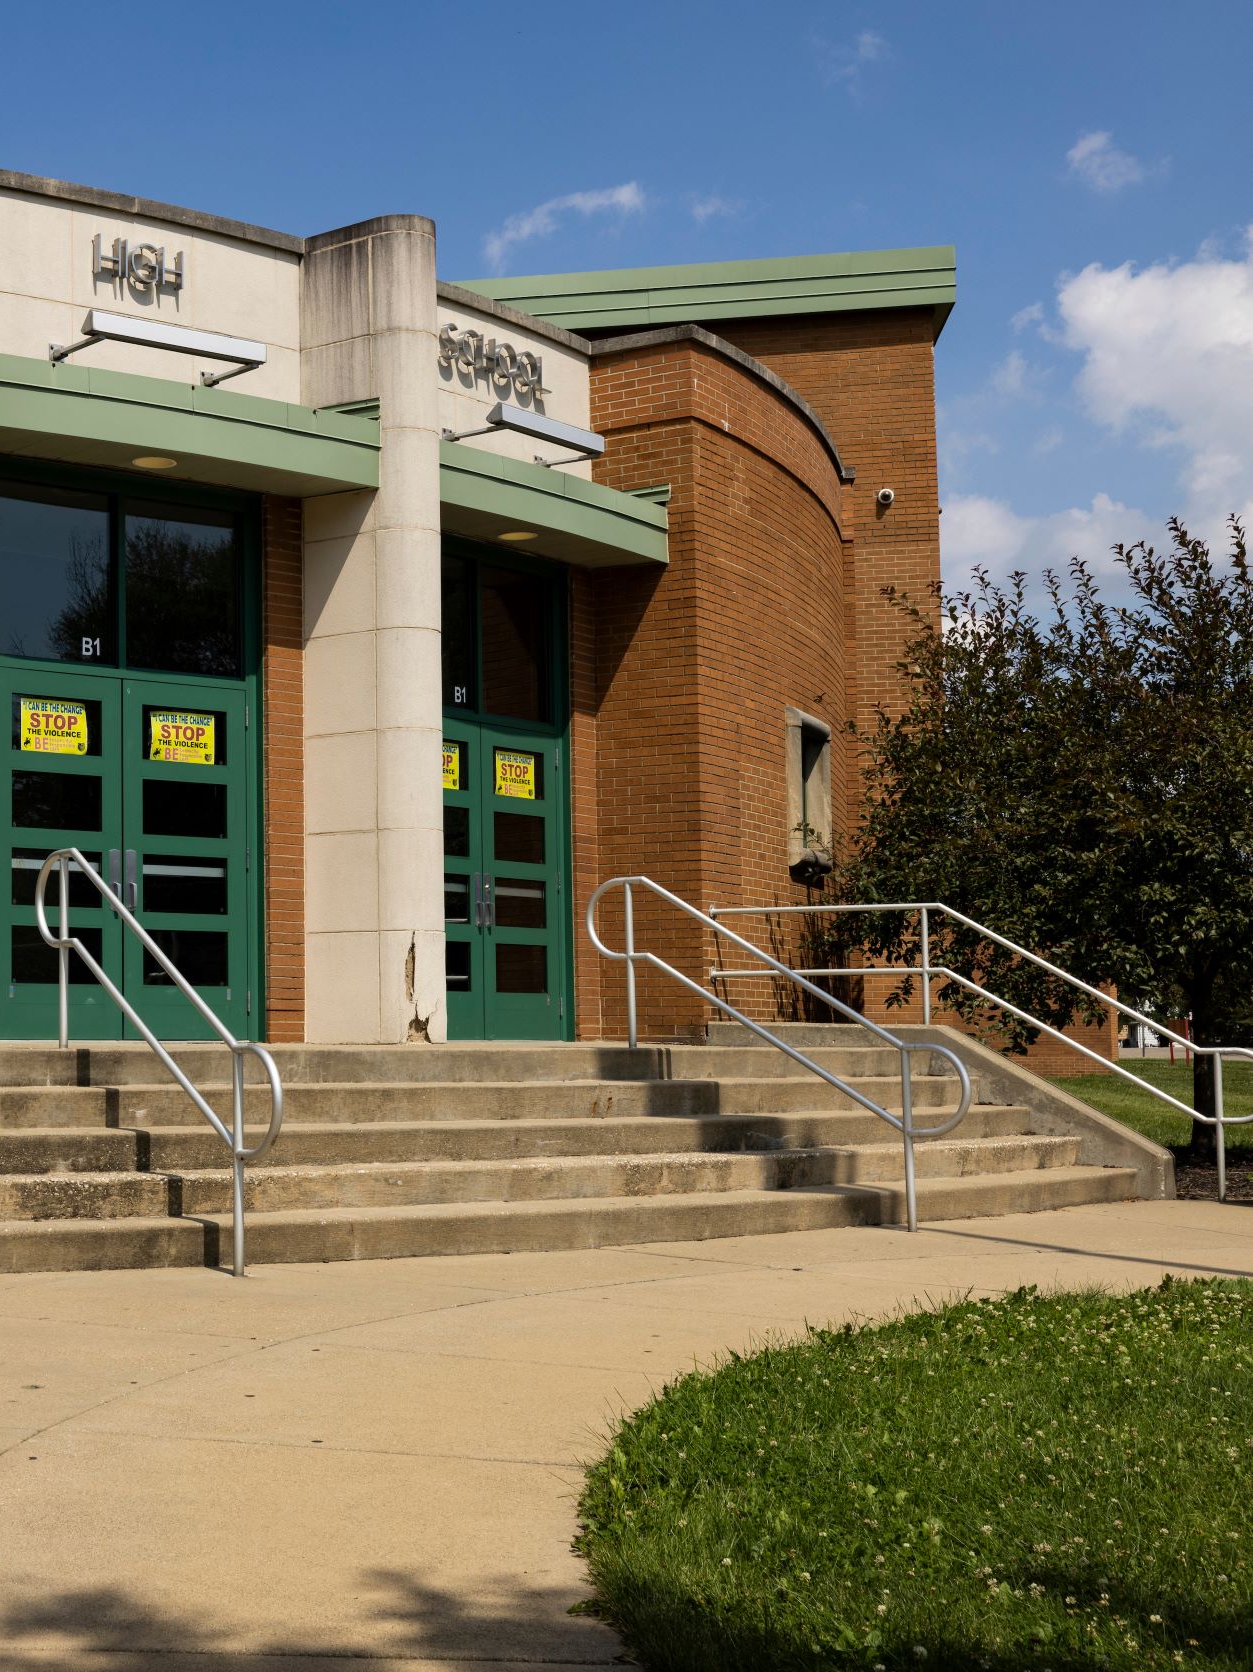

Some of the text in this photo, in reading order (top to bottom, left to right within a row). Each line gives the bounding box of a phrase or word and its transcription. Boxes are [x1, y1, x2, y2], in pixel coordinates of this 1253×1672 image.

[93, 233, 184, 290] HIGH
[439, 323, 552, 394] SCHOOL
[82, 637, 100, 656] B1
[454, 686, 466, 703] B1
[28, 702, 39, 710] CAN
[42, 702, 48, 711] BE
[49, 704, 60, 712] THE
[30, 712, 78, 730] STOP
[158, 714, 170, 722] CAN
[170, 715, 178, 723] BE
[179, 716, 188, 724] THE
[44, 730, 82, 738] VIOLENCE
[160, 724, 206, 741] STOP
[34, 736, 48, 750] BE
[158, 738, 208, 749] THE VIOLENCE
[164, 748, 178, 760] BE
[501, 762, 528, 778] STOP
